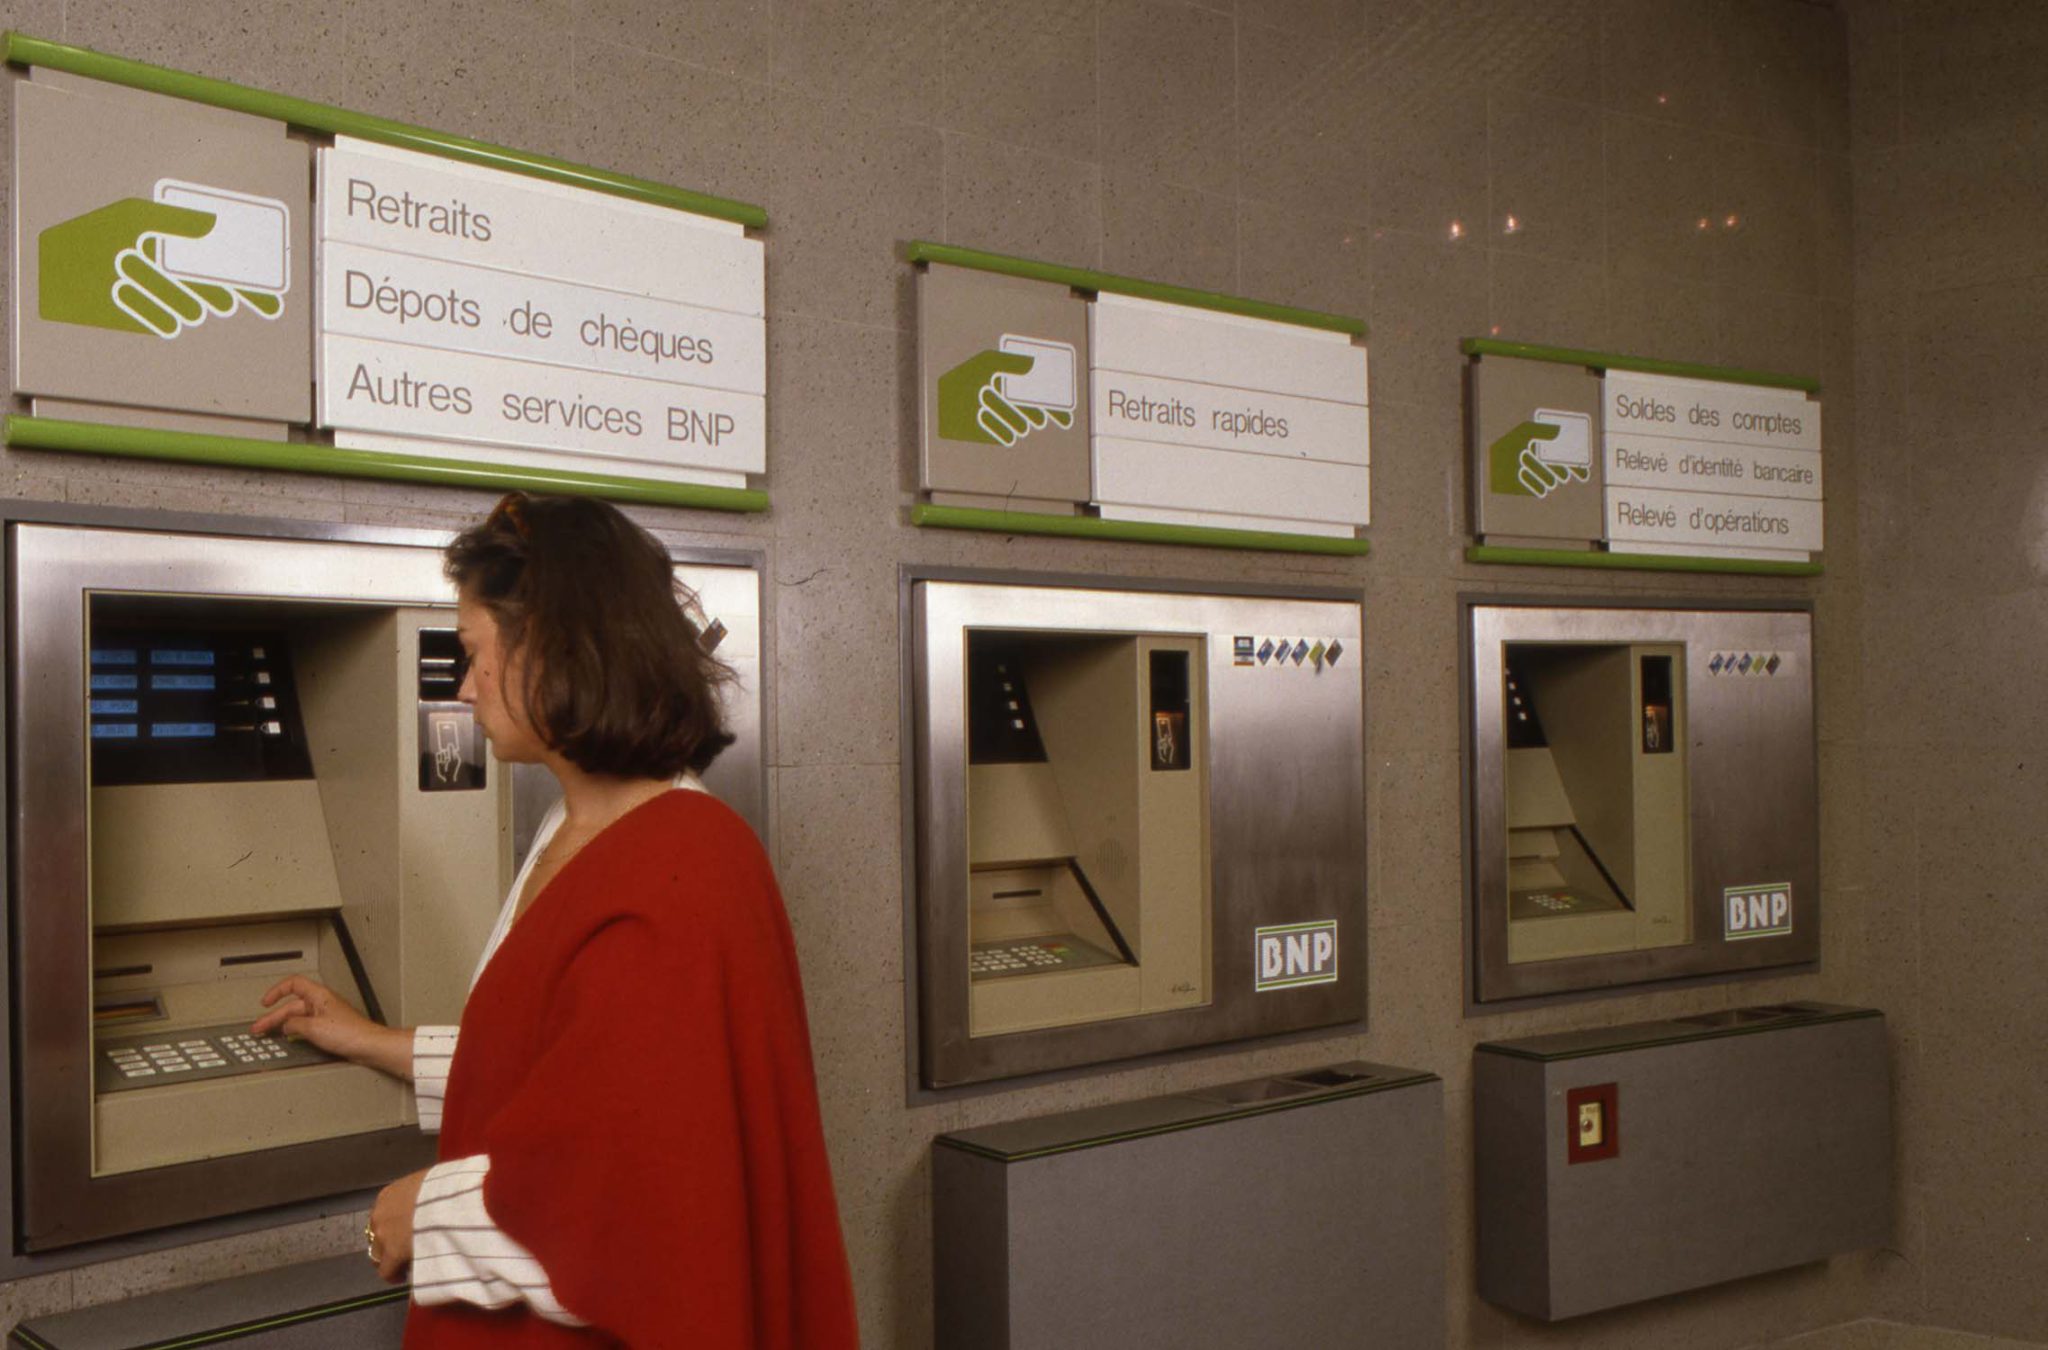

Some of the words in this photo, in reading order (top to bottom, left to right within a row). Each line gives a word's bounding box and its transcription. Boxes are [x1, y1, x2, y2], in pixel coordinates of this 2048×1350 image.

[347, 178, 492, 242] Retraits
[345, 269, 481, 328] Dépots
[510, 300, 553, 339] de
[580, 313, 714, 364] chèques
[346, 363, 473, 415] Autres
[502, 391, 643, 437] services
[667, 406, 735, 447] BNP
[1108, 390, 1196, 427] Retraits
[1212, 406, 1290, 440] rapides
[1616, 394, 1677, 424] Soldes
[1688, 402, 1721, 428] des
[1732, 412, 1803, 438] comptes
[1615, 447, 1669, 473] Relevé
[1679, 455, 1744, 479] d'identité
[1753, 461, 1814, 485] bancaire
[1617, 501, 1677, 528] Relevé
[1689, 507, 1790, 536] d'opérations
[1729, 892, 1788, 931] BNP
[1262, 931, 1333, 979] BNP
